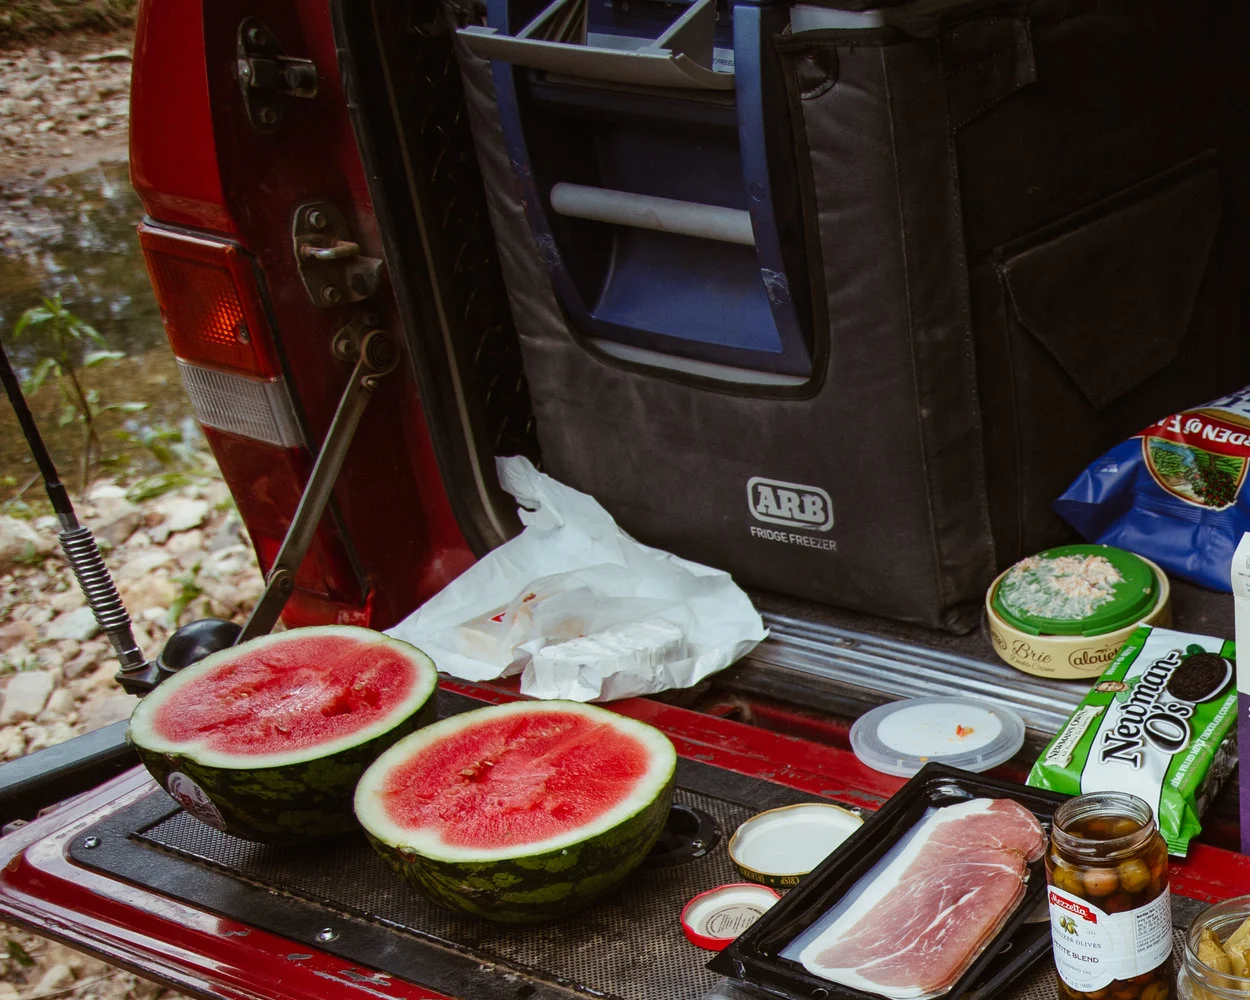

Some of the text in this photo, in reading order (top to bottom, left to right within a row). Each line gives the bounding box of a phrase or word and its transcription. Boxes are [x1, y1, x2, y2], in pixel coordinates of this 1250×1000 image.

[1183, 418, 1203, 435] of
[756, 484, 826, 524] ARB
[750, 526, 837, 551] FRIDGE FREEZER
[1012, 639, 1054, 664] Brie
[1101, 650, 1181, 770] Newman-
[780, 875, 800, 886] CRISP
[1051, 894, 1089, 917] Mezzetta
[1075, 939, 1102, 949] OLIVES
[1072, 951, 1100, 964] BLEND
